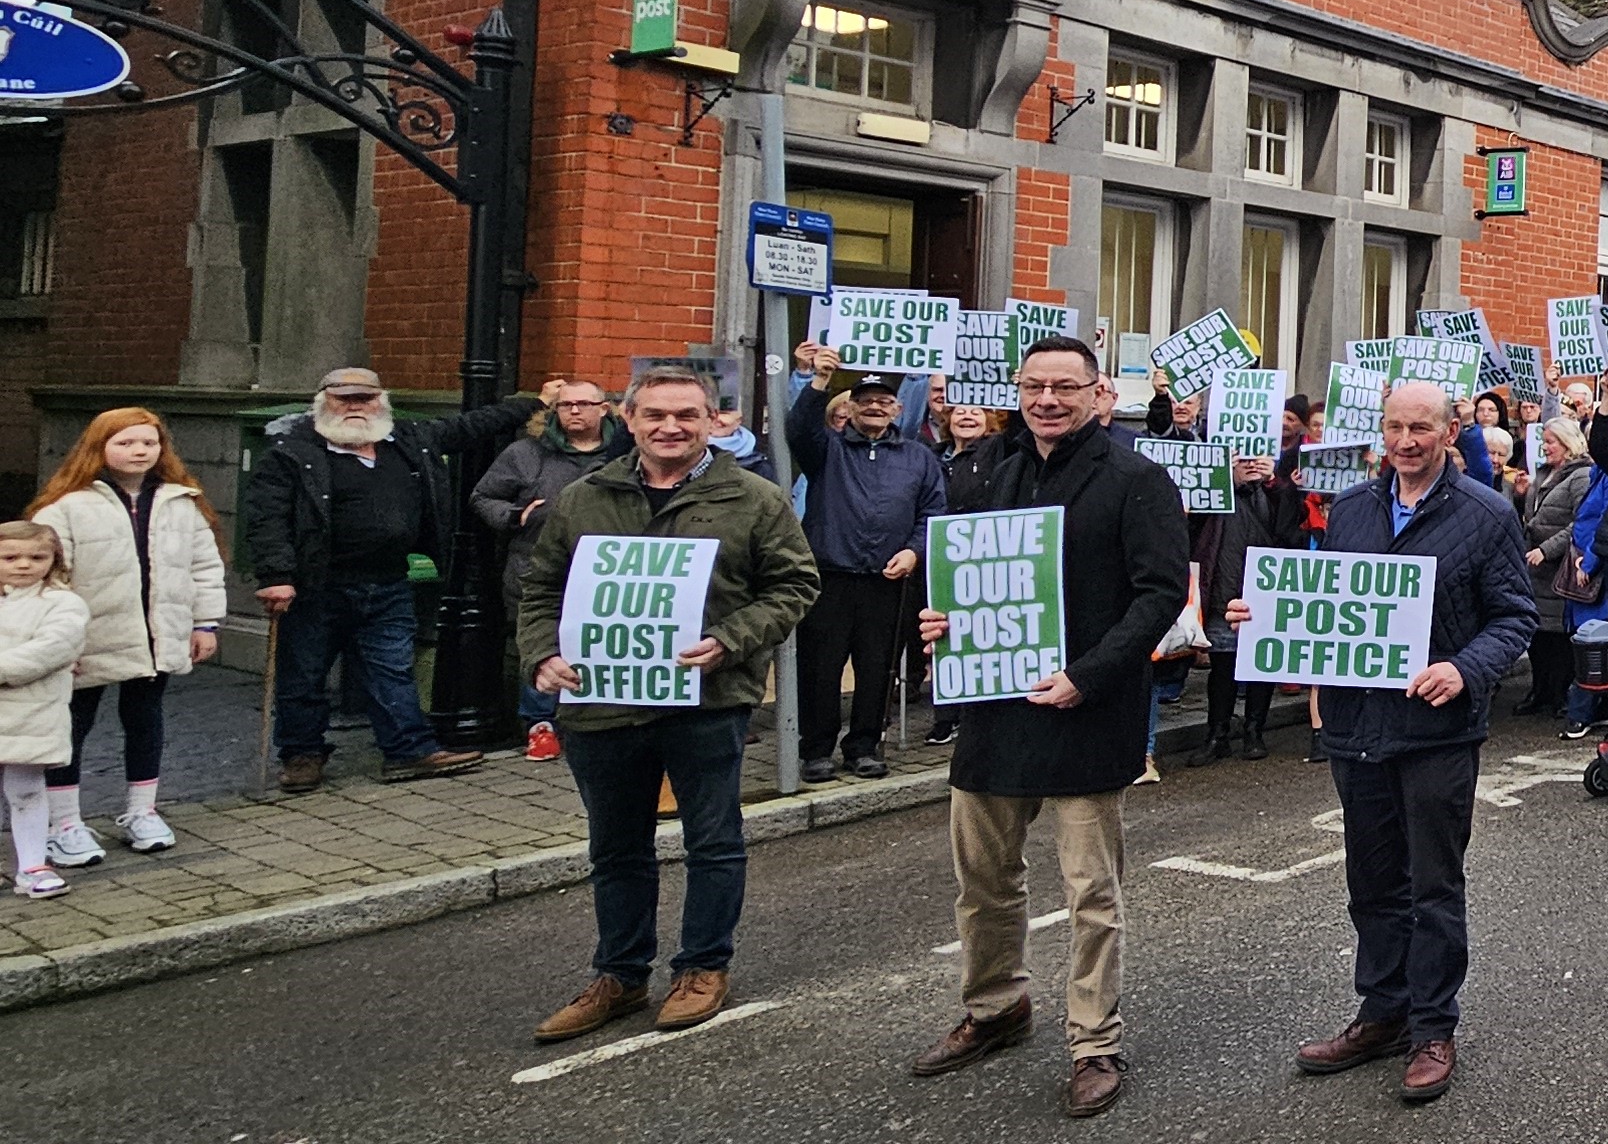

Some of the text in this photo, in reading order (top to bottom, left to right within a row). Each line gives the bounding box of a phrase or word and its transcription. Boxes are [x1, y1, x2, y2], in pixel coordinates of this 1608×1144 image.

[768, 240, 816, 254] Luan Sath
[769, 262, 814, 275] MON SAT
[840, 296, 948, 322] SAVE OUR
[1016, 302, 1067, 328] SAVE
[1556, 298, 1593, 318] SAVE
[851, 321, 934, 345] POST
[957, 314, 1010, 336] SAVE
[1443, 312, 1480, 336] SAVE
[1559, 319, 1591, 337] OUR
[956, 337, 1005, 360] OUR
[1152, 313, 1227, 367] SAVE OUR
[1354, 341, 1392, 358] SAVE
[1395, 338, 1477, 364] SAVE OUR
[1558, 338, 1595, 357] POST
[839, 344, 943, 369] OFFICE
[1169, 334, 1228, 378] POST
[1506, 344, 1536, 362] SAVE
[954, 360, 1010, 382] POST
[1174, 346, 1248, 397] OFFICE
[1401, 358, 1463, 381] POST
[1510, 361, 1535, 377] OUR
[1555, 356, 1604, 376] OFFICE
[1223, 370, 1276, 390] SAVE
[1516, 376, 1538, 392] POST
[947, 382, 1018, 406] OFFICE
[1225, 391, 1268, 411] OUR
[1340, 386, 1382, 410] OUR
[1513, 388, 1543, 404] OFFICE
[1218, 412, 1272, 434] POST
[1333, 406, 1384, 432] POST
[1140, 441, 1225, 467] SAVE OUR
[1309, 449, 1361, 469] POST
[1300, 467, 1365, 490] OFFICE
[945, 513, 1044, 562] SAVE
[593, 540, 696, 577] SAVE
[954, 559, 1035, 606] OUR
[1256, 555, 1422, 598] SAVE OUR
[592, 581, 677, 618] OUR
[948, 603, 1045, 652] POST
[1274, 597, 1398, 637] POST
[581, 623, 680, 660] POST
[1254, 637, 1410, 680] OFFICE
[569, 663, 692, 701] OFFICE
[938, 647, 1059, 698] OFFICE
